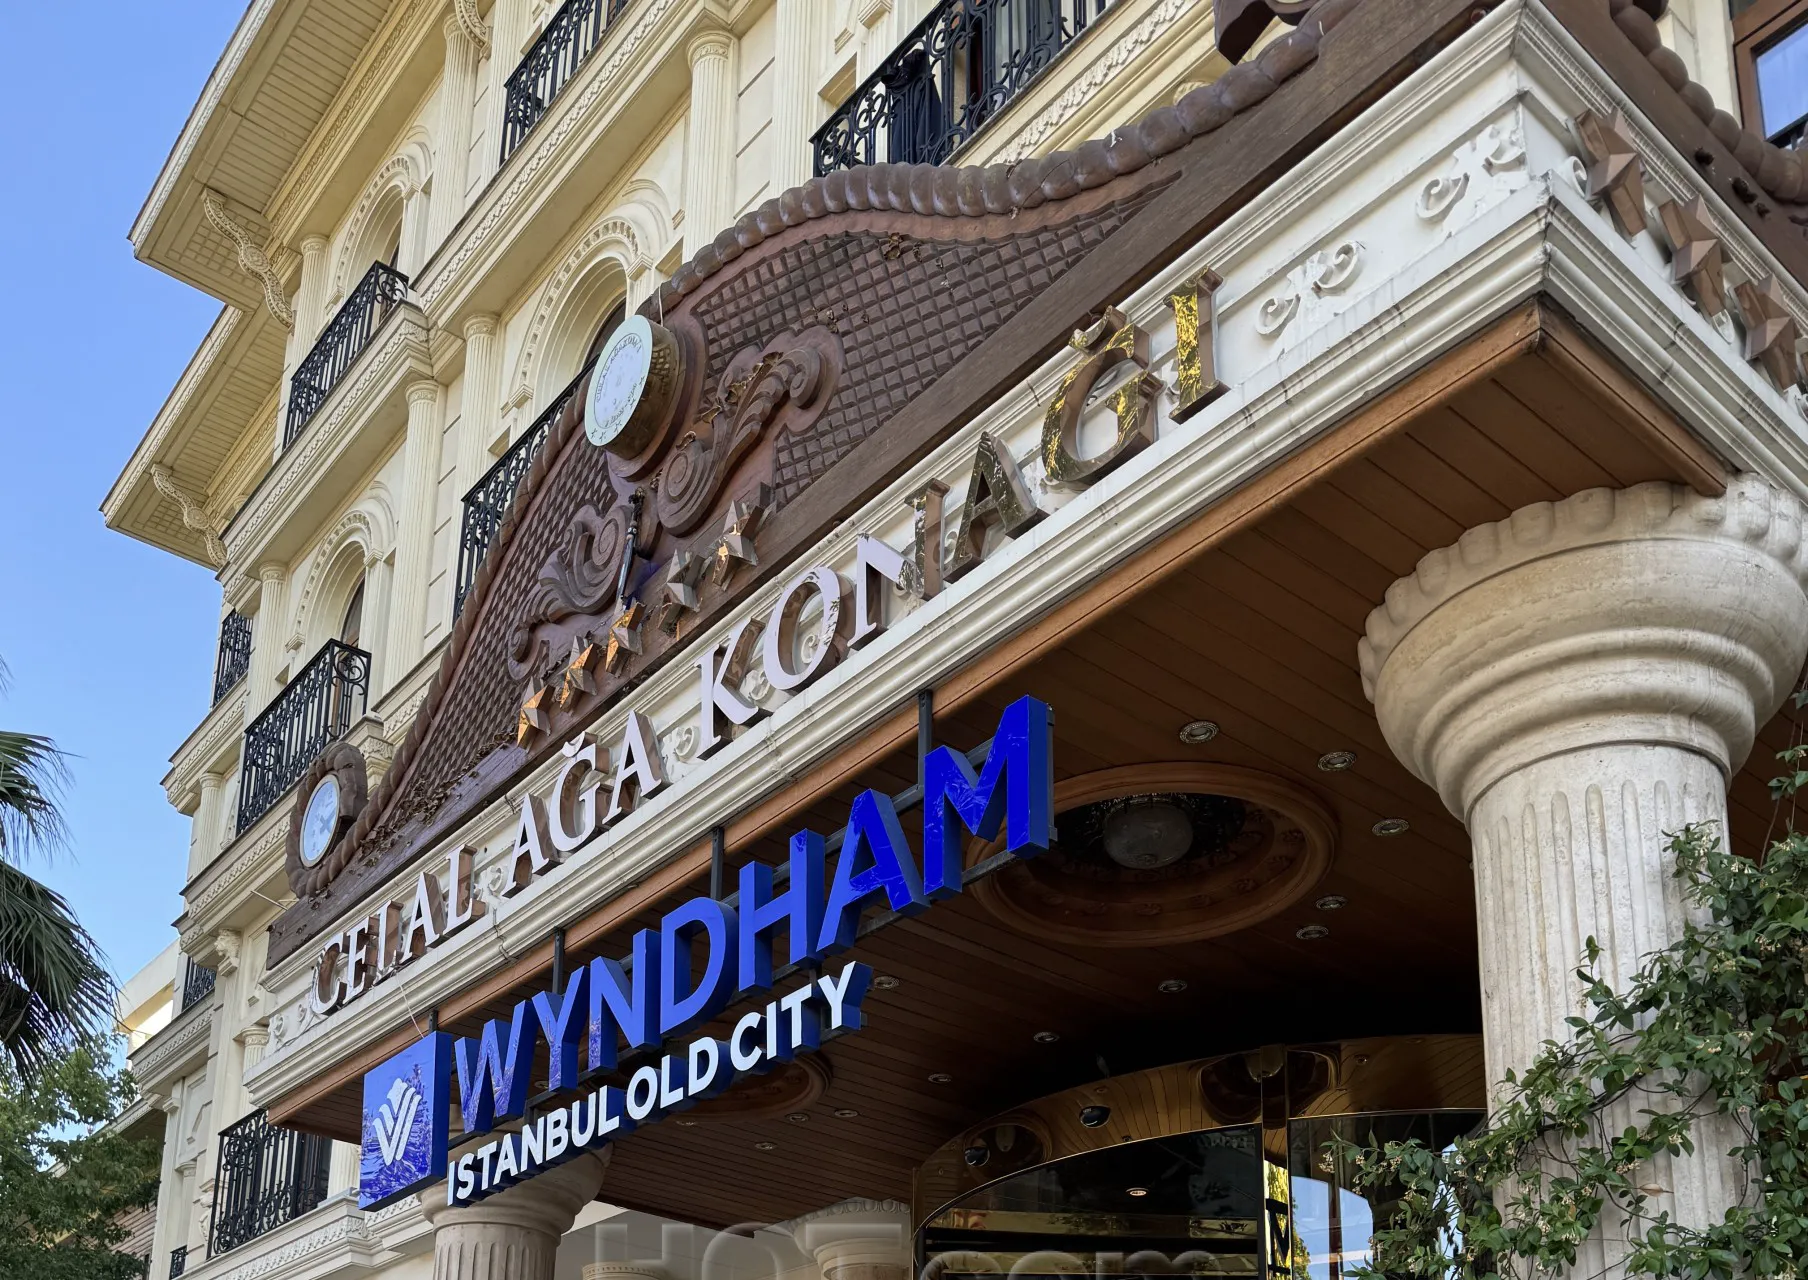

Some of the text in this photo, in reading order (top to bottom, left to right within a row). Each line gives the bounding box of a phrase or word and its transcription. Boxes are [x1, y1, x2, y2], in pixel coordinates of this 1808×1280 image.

[312, 266, 1230, 1015] CELAL AĞA KONAĞI
[447, 960, 873, 1207] ISTANBUL OLD CITY
[454, 694, 1051, 1135] WYNDHAM
